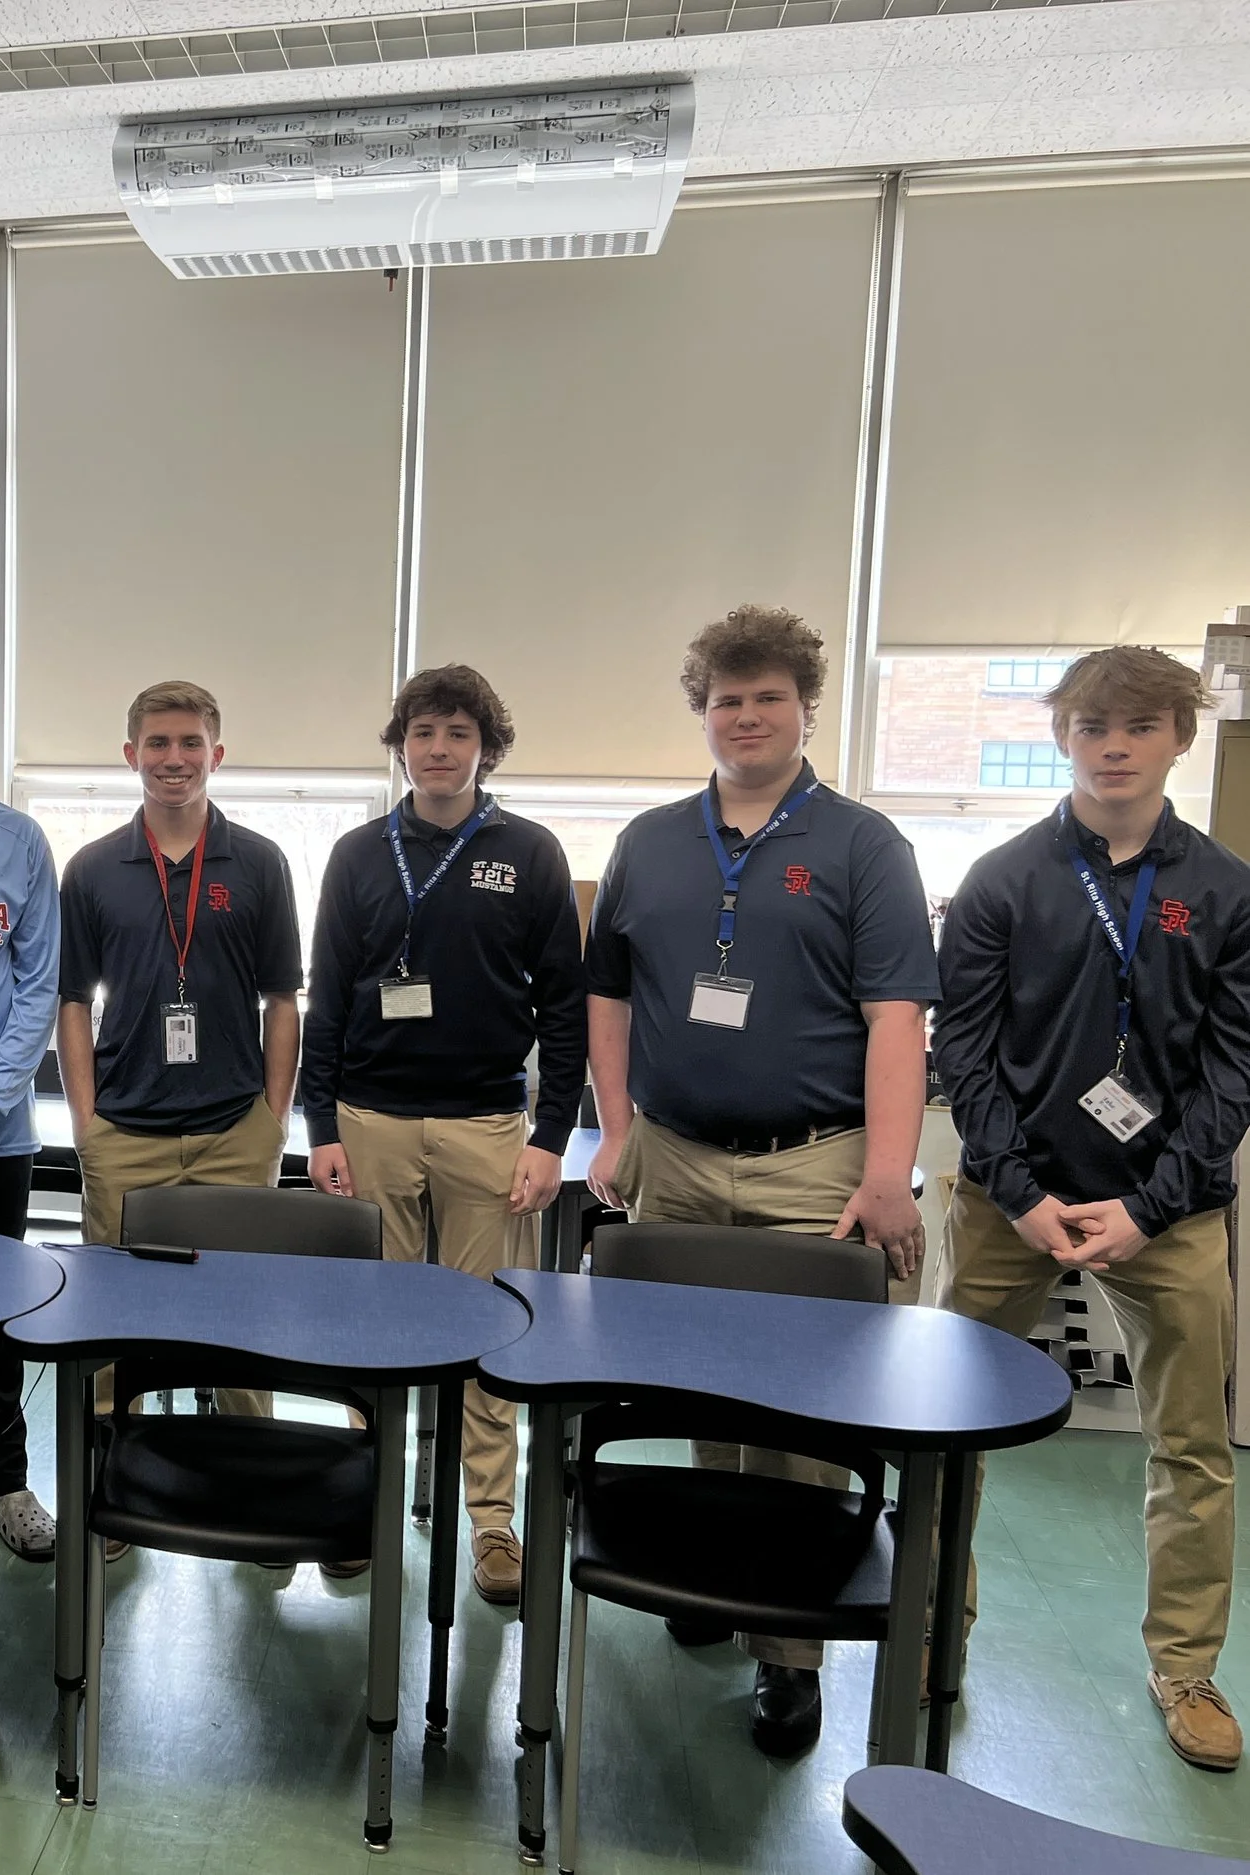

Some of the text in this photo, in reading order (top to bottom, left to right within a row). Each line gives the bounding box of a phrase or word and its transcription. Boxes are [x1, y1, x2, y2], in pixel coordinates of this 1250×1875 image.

[392, 840, 402, 854] Rita
[397, 854, 407, 873] High
[424, 875, 438, 890] Rita
[434, 861, 449, 877] High
[445, 837, 465, 862] School
[492, 861, 516, 874] RITA
[401, 871, 414, 896] School
[471, 880, 515, 894] MUSTANGS
[484, 869, 502, 885] 21
[785, 864, 812, 896] SR
[208, 883, 232, 912] SR
[1080, 870, 1125, 951] St. Rita High School
[1159, 898, 1191, 936] SR
